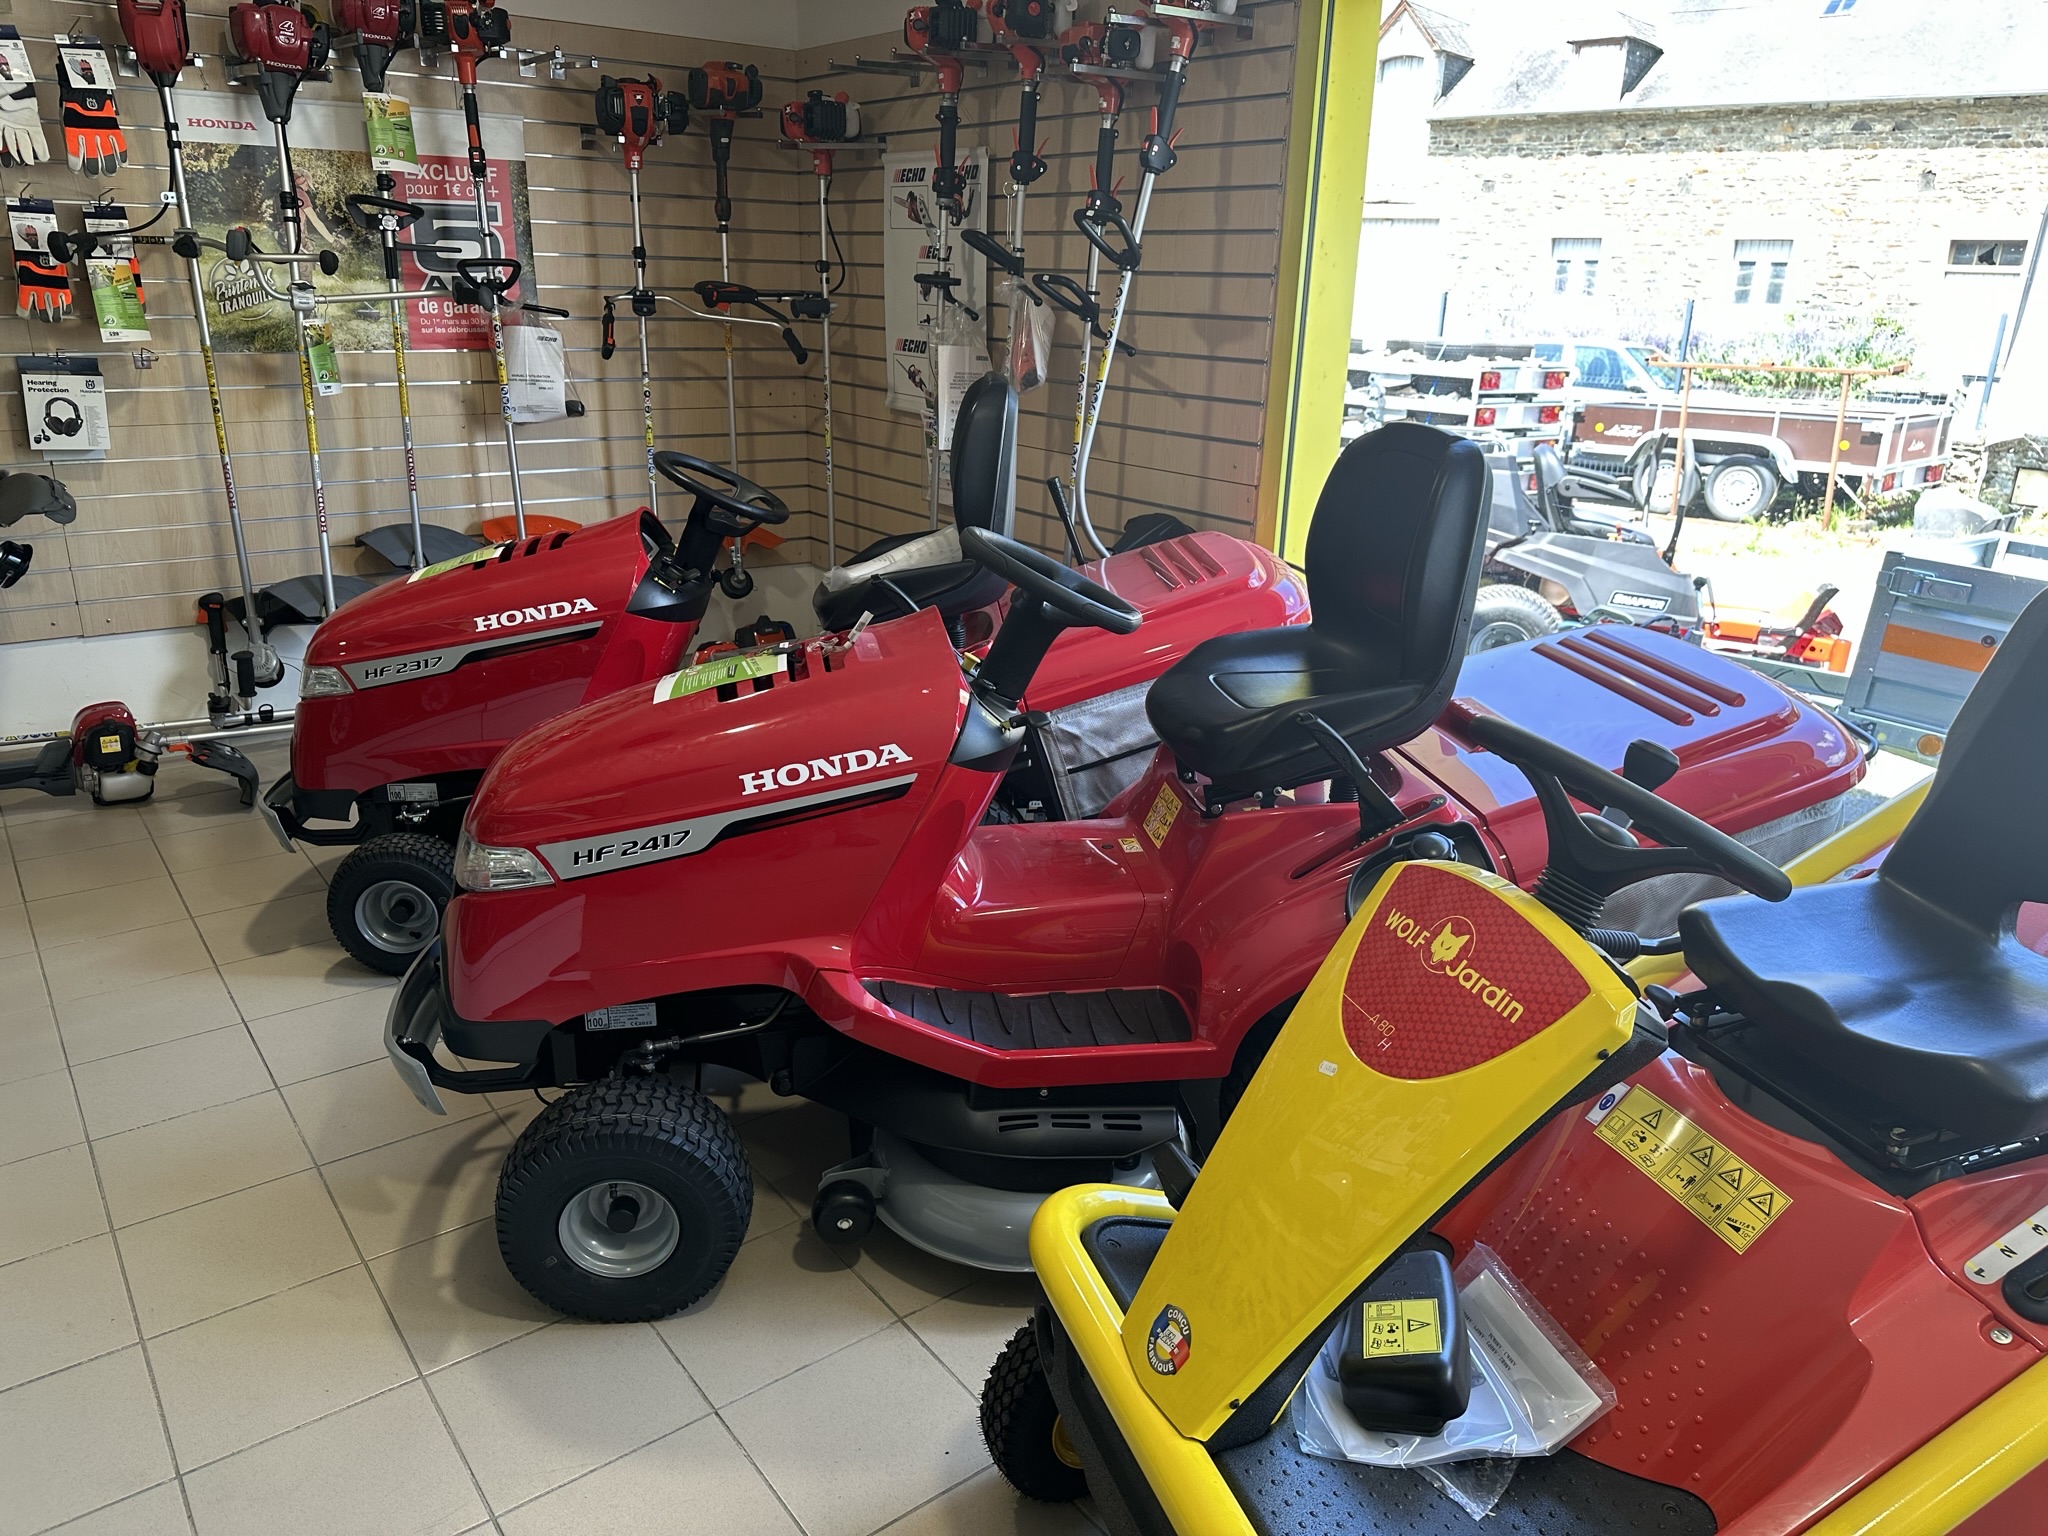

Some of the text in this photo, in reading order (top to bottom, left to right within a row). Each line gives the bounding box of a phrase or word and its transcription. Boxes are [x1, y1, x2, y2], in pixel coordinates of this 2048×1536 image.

[279, 20, 294, 31] 4
[362, 33, 392, 41] HONDA
[266, 60, 302, 70] HONDA
[187, 118, 258, 131] HONDA
[900, 167, 926, 183] ECHO
[406, 184, 438, 197] pour
[443, 183, 461, 196] 1€
[488, 186, 499, 198] +
[407, 199, 505, 274] 5
[926, 245, 952, 259] ECO
[214, 268, 276, 300] Printems
[219, 287, 275, 314] TRANQUIL
[419, 298, 438, 314] de
[902, 338, 927, 353] ECHO
[406, 446, 417, 492] HONDA
[222, 460, 236, 510] HONDA
[317, 486, 328, 534] HONDA
[474, 597, 598, 632] HONDA
[364, 656, 444, 681] HF 2317
[739, 743, 913, 795] HONDA
[573, 830, 692, 867] HF 2417
[1384, 908, 1431, 949] WOLF
[1444, 960, 1525, 1024] Jardin
[588, 1017, 603, 1028] 100
[1377, 1037, 1392, 1052] H
[1726, 1216, 1738, 1225] MAX
[2031, 1223, 2048, 1236] 3
[1999, 1245, 2018, 1258] 2
[1974, 1267, 1986, 1278] 1
[1167, 1309, 1189, 1335] CONÇU
[1156, 1328, 1179, 1355] FRANCE
[1164, 1329, 1176, 1339] EN
[1149, 1336, 1175, 1373] FABRIQUÉ
